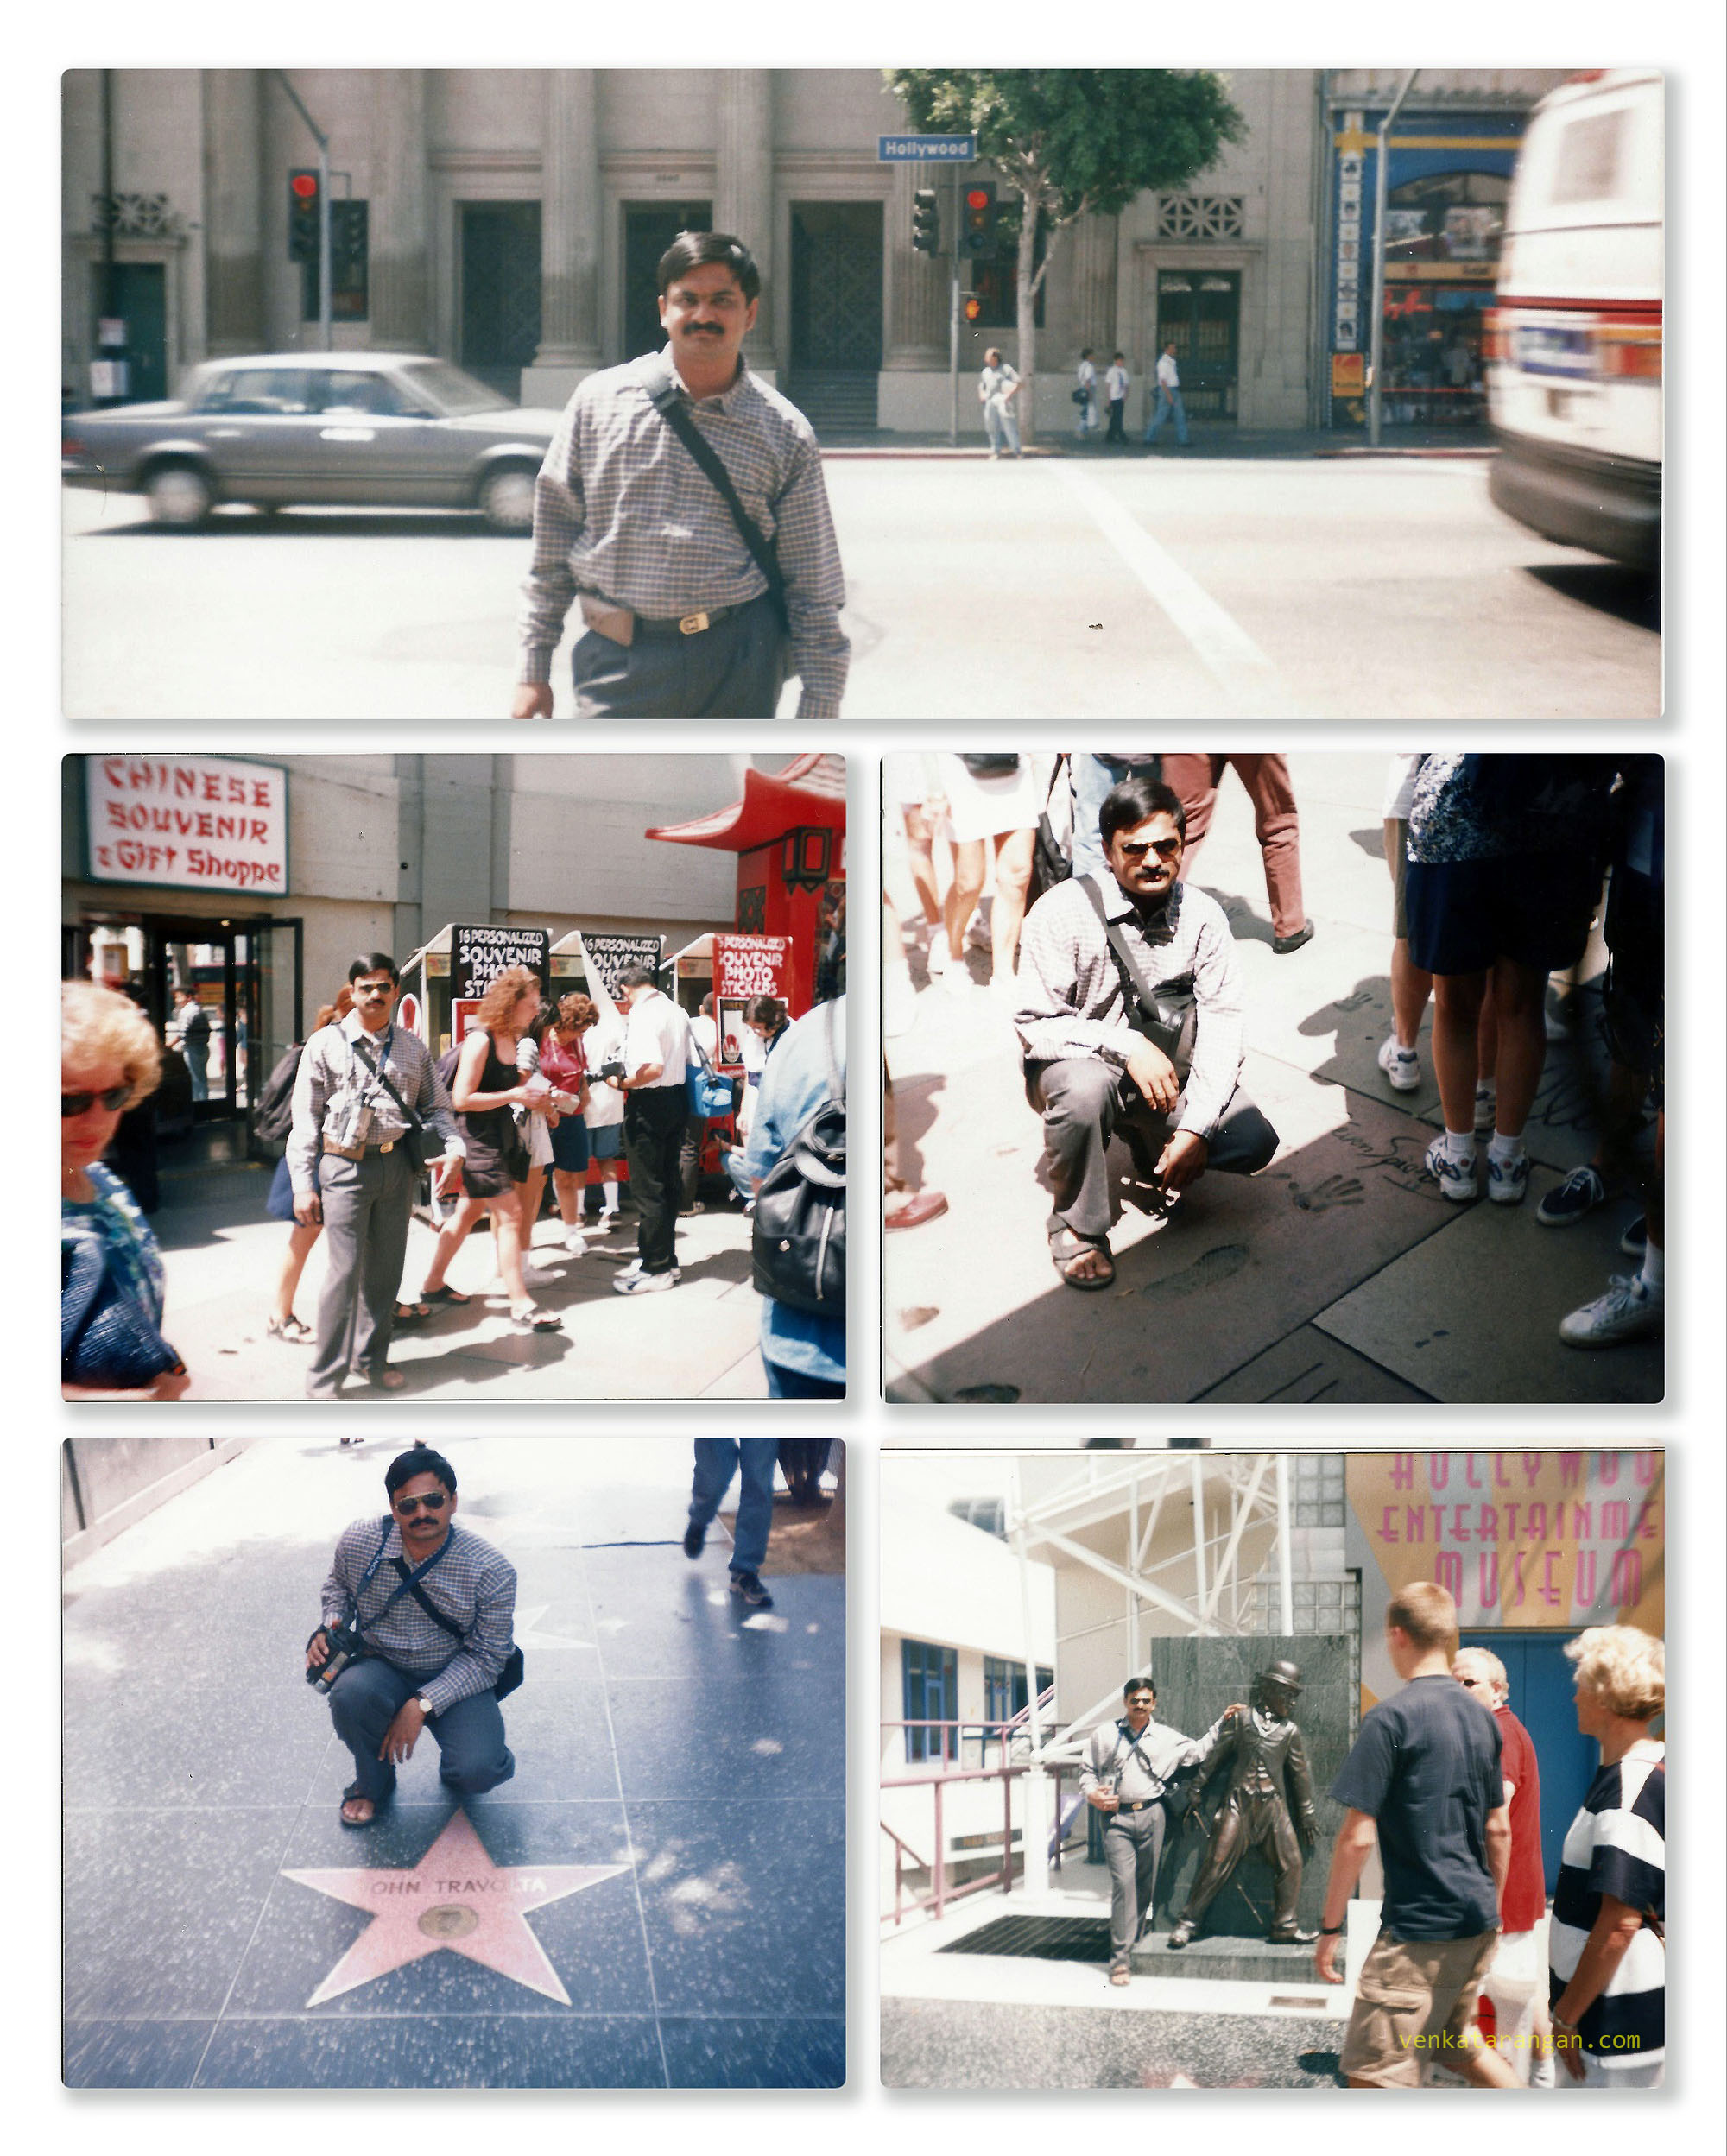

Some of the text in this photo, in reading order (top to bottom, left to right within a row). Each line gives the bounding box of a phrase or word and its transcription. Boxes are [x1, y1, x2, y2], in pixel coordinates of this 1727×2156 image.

[885, 141, 968, 157] Hollywood
[103, 758, 271, 809] CHINESE
[106, 800, 268, 844] SOUVENIR
[187, 849, 280, 887] Shoppe
[459, 929, 544, 946] 16 PERSONALIZED
[593, 938, 660, 953] PERSONALIZED
[459, 945, 542, 966] SOUVENIR
[473, 963, 529, 980] PHO
[725, 965, 774, 982] PHOTO
[721, 980, 778, 996] STICKERS
[1435, 1549, 1642, 1609] MUSEUM
[371, 1881, 421, 1895] OHN
